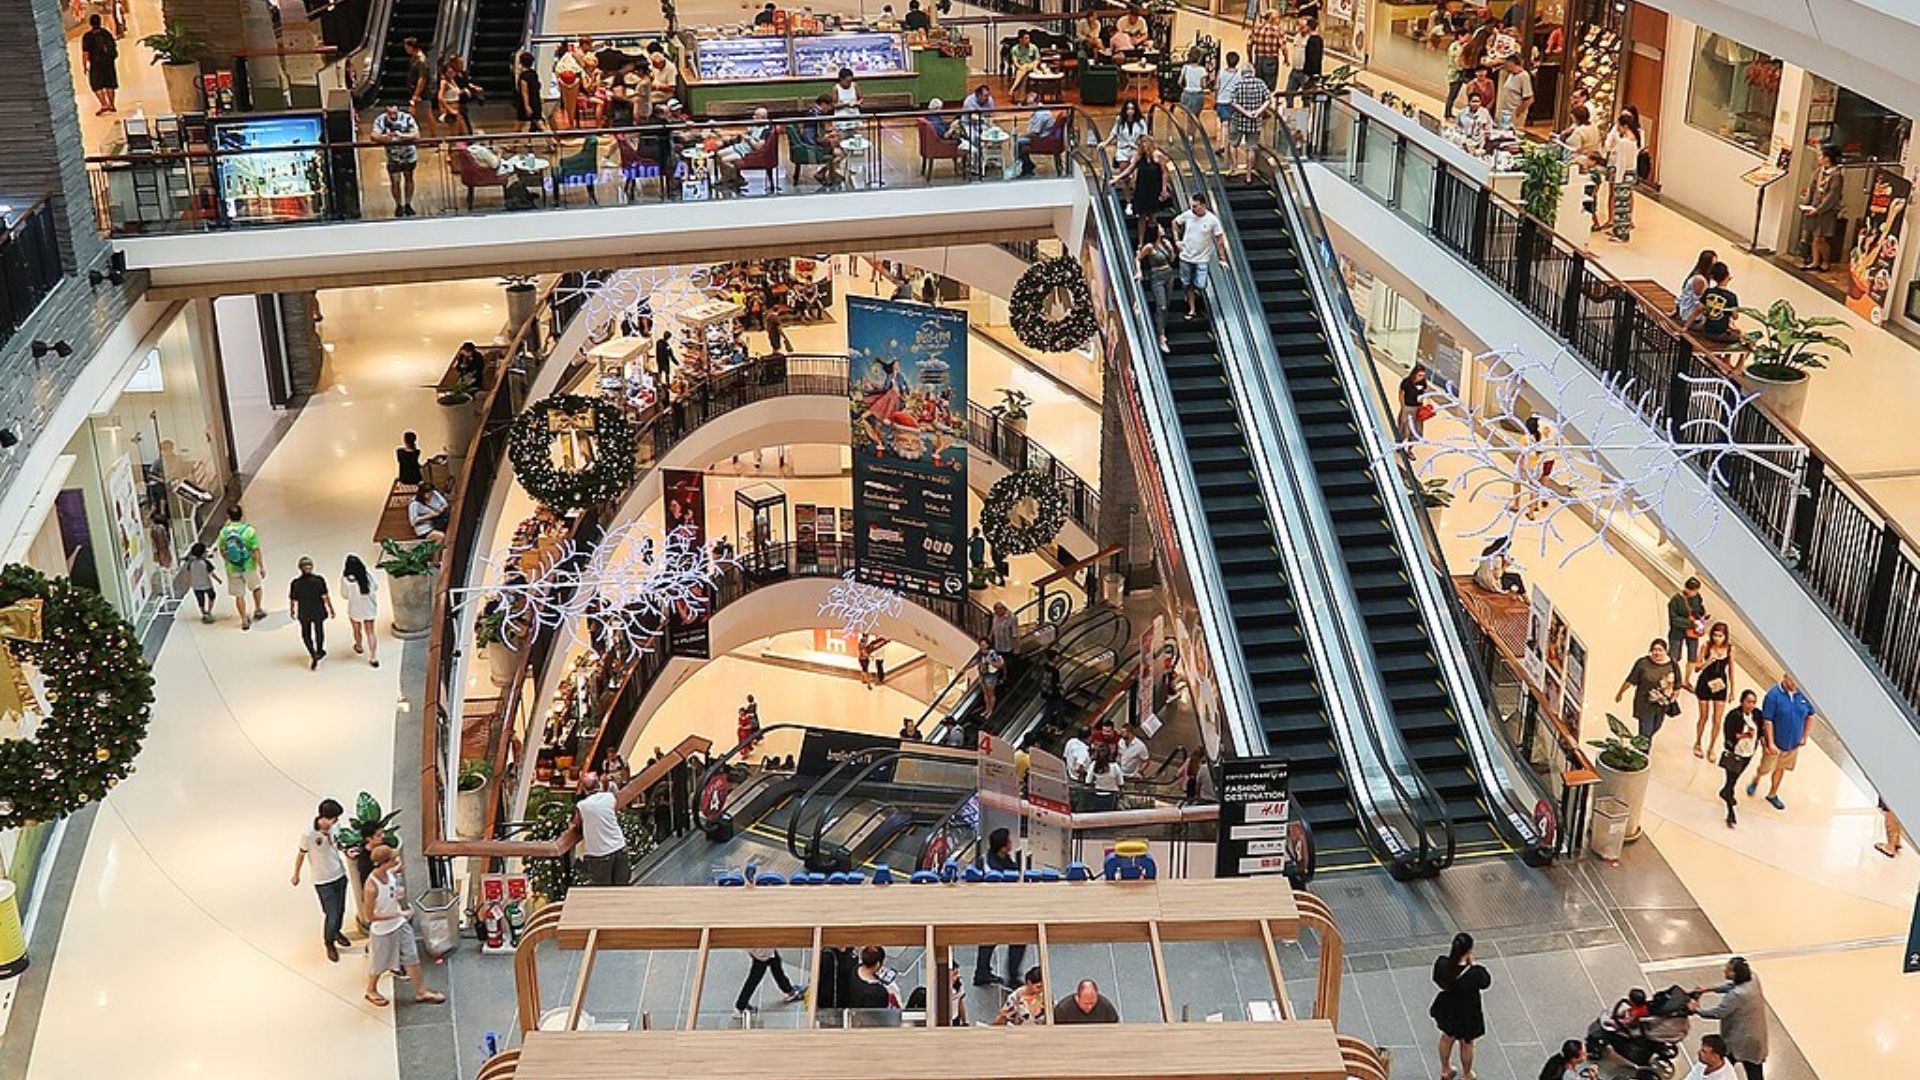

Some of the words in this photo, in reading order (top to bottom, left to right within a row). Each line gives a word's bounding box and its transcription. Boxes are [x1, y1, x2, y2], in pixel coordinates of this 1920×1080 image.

[1052, 605, 1061, 620] 3
[979, 735, 993, 756] 4
[1224, 791, 1285, 801] DESTINATION
[1225, 784, 1266, 793] FASHION
[710, 789, 720, 811] 4
